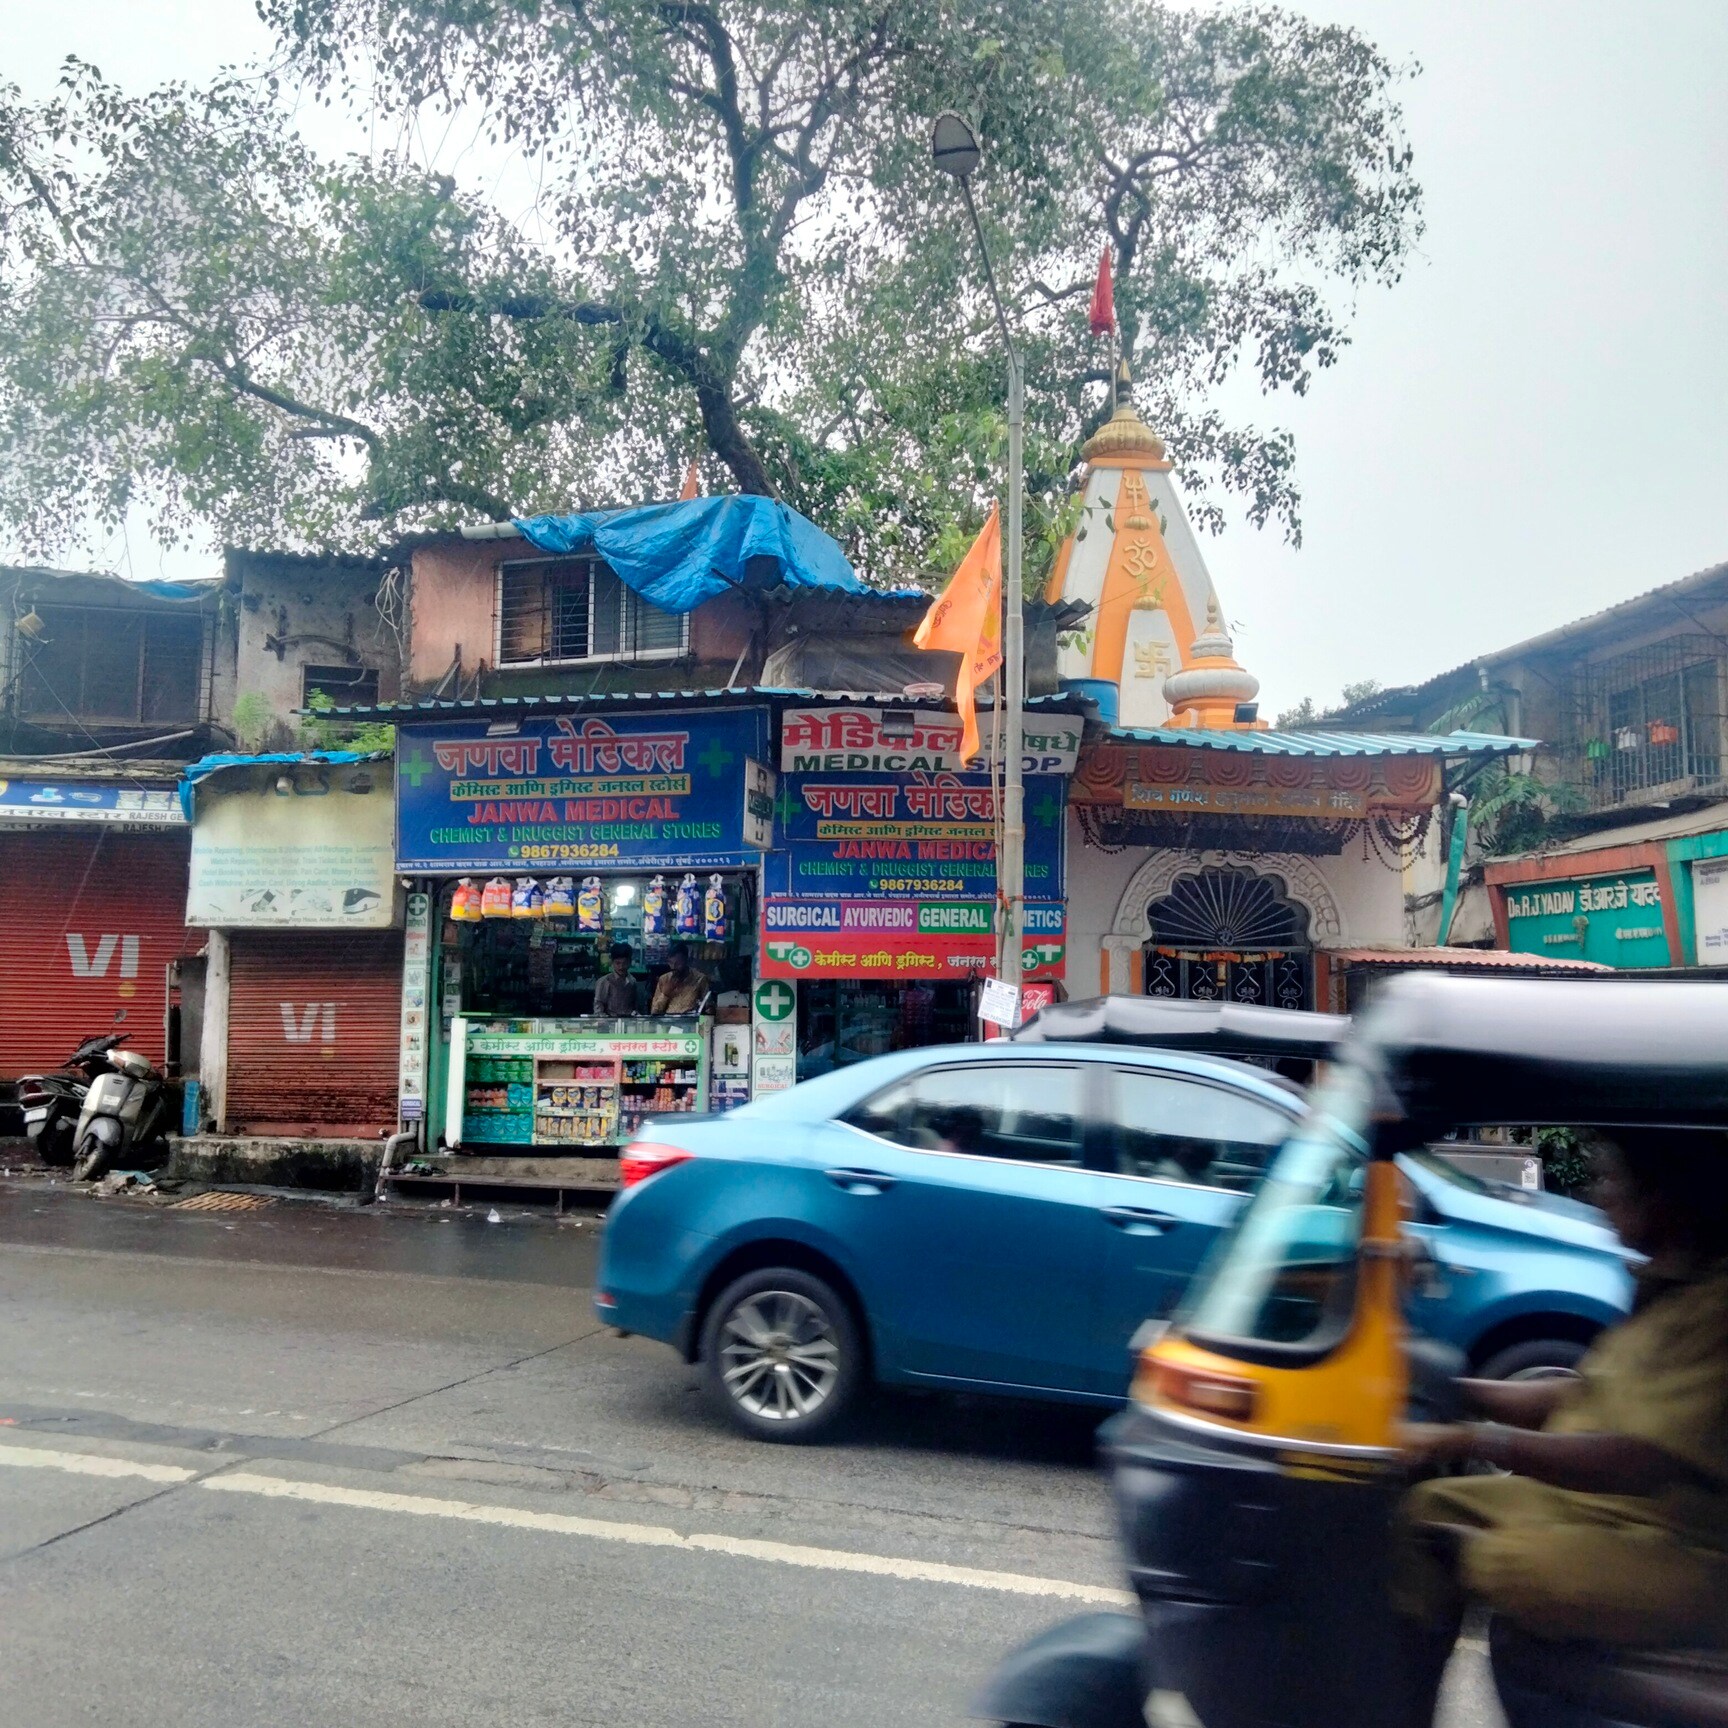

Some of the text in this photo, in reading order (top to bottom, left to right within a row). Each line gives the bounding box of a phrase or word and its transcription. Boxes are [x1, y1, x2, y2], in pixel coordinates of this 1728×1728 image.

[783, 712, 964, 752] मेडिकल
[548, 717, 689, 774] मेडिकल
[793, 754, 1062, 772] MEDICAL SHOP
[452, 781, 500, 798] केमिस्ट
[505, 780, 545, 796] आणि
[597, 779, 643, 794] जनरल
[649, 775, 687, 792] स्टोर्स
[905, 771, 1005, 821] मेडिक
[129, 812, 168, 820] RAJESH
[467, 798, 680, 824] JANWA MEDICAL
[430, 821, 722, 844] CHEMIST & DRUGGIST GENERAL STORES
[866, 823, 901, 836] आणि
[946, 825, 986, 836] जनरल
[520, 843, 620, 858] 9867936284
[833, 841, 997, 859] JANWA MEDICA
[799, 862, 854, 876] CHEMIST
[859, 862, 868, 876] &
[872, 862, 936, 876] DRUGGIST
[940, 862, 997, 877] GENERAL
[880, 879, 964, 891] 9867936284
[766, 906, 841, 927] SURGICAL
[843, 907, 913, 927] AYURVEDIC
[919, 907, 988, 928] GENERAL
[814, 950, 857, 967] केमीस्ट
[860, 950, 892, 967] आणि
[947, 955, 986, 968] जनरल
[480, 1038, 520, 1050] केमीस्ट
[524, 1038, 554, 1051] आणि
[609, 1042, 647, 1051] जनरल
[652, 1039, 678, 1052] स्टोर
